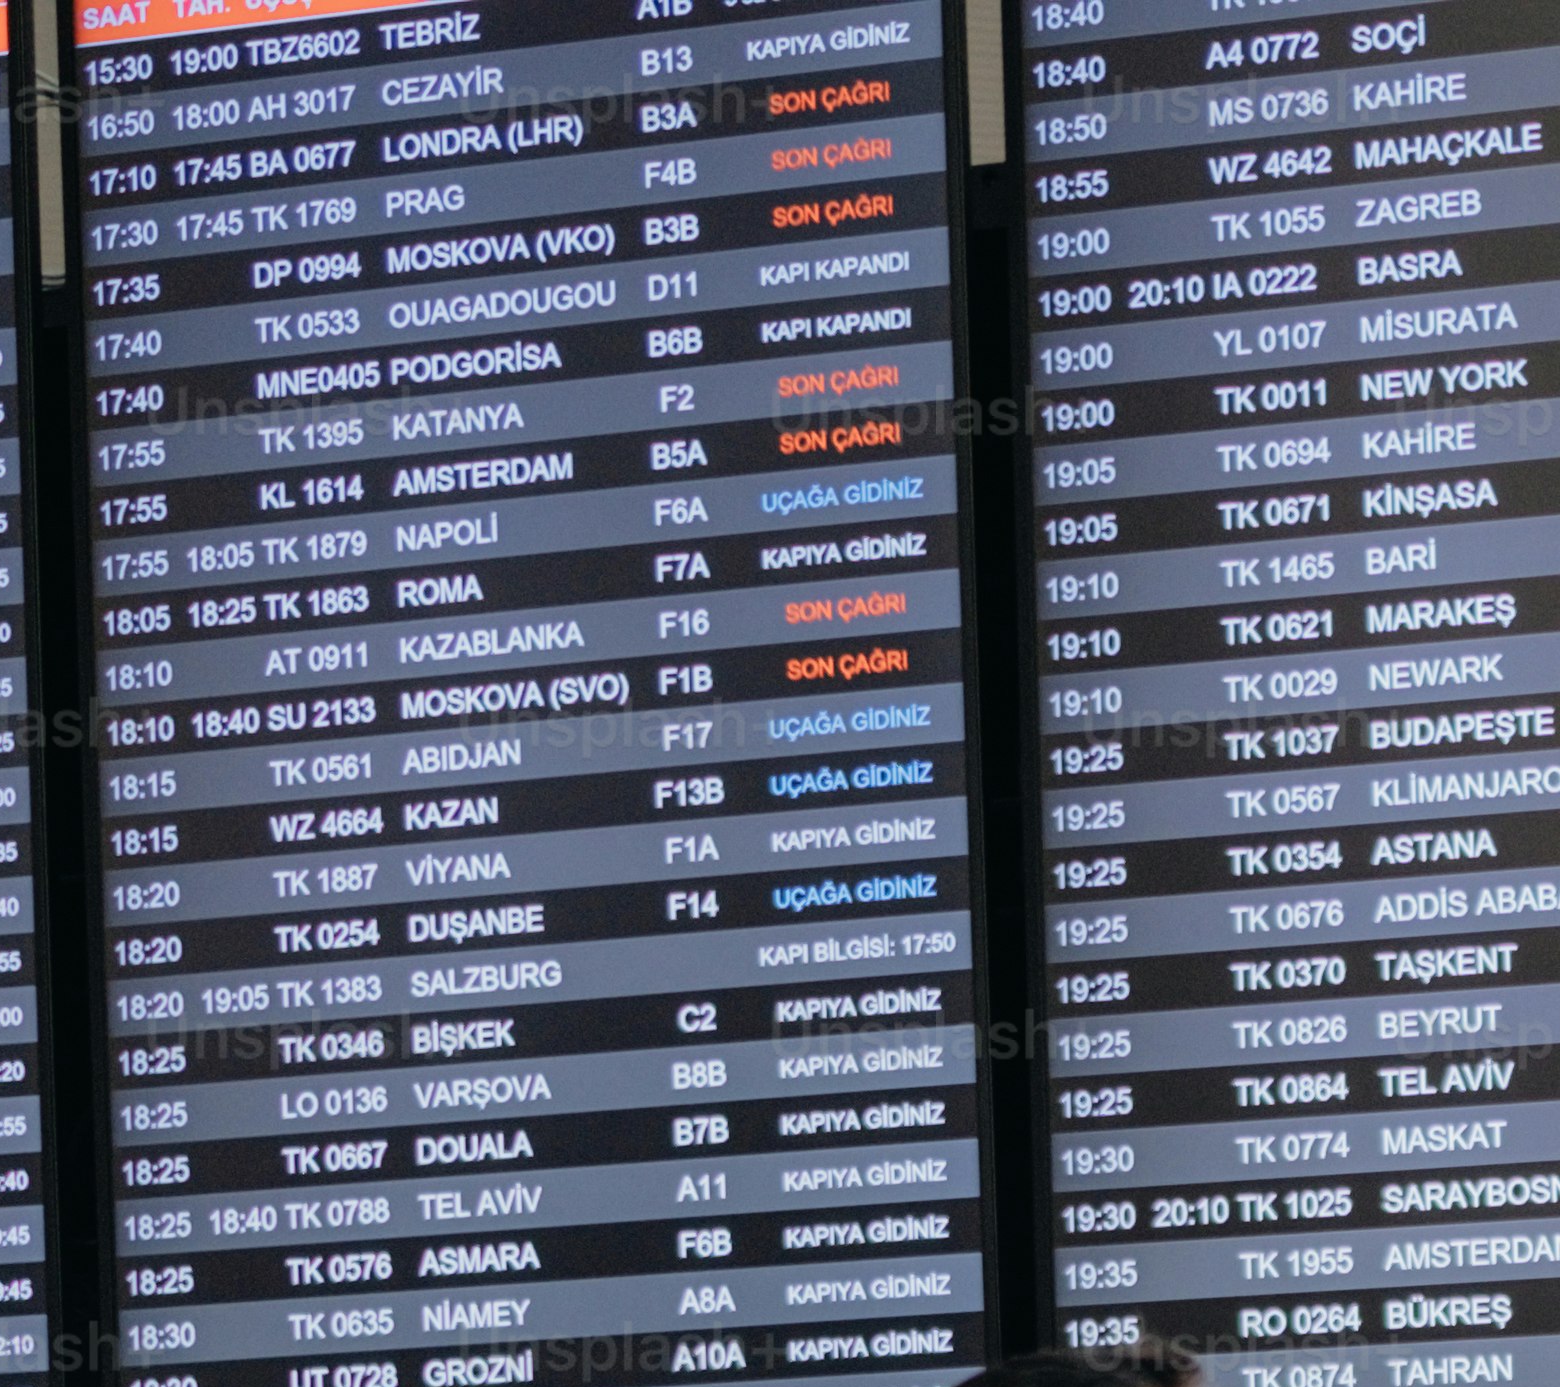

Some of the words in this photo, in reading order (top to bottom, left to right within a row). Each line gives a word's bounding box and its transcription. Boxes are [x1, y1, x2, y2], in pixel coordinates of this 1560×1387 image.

[89, 163, 157, 196] 17:10
[173, 153, 243, 186] 17:45
[249, 149, 289, 178] BA
[292, 139, 357, 173] 0677
[381, 123, 503, 163] LONDRA
[505, 115, 584, 155] (LHR)
[639, 101, 698, 133] B3A
[769, 89, 817, 115] SON
[820, 80, 890, 113] ÇAĞRI
[1035, 169, 1110, 203] 18:55
[1207, 153, 1259, 185] WZ
[1262, 145, 1333, 179] 4642
[1353, 122, 1544, 170] MAHAÇKALE
[96, 384, 165, 417] 17:40
[255, 360, 381, 400] MNE0405
[389, 340, 563, 386] PODGORİSA
[646, 325, 704, 359] B6B
[760, 318, 812, 344] KAPI
[815, 307, 912, 338] KAPANDI
[1041, 398, 1115, 432] 19:00
[1213, 384, 1257, 416] TK
[1260, 378, 1327, 411] 0011
[1359, 367, 1434, 402] NEW
[1438, 358, 1529, 394] YORK
[102, 549, 170, 581] 17:55
[186, 541, 255, 573] 18:05
[260, 536, 300, 565] TK
[306, 529, 368, 561] 1879
[395, 511, 499, 552] NAPOLİ
[653, 495, 709, 527] F6A
[760, 483, 840, 516] UÇAĞA
[842, 475, 924, 505] GİDİNİZ
[121, 1100, 188, 1131] 18:25
[280, 1091, 319, 1120] LO
[324, 1085, 388, 1116] 0136
[412, 1073, 552, 1110] VARŞOVA
[671, 1058, 727, 1090] B8B
[778, 1053, 859, 1079] KAPIYA
[861, 1044, 944, 1073] GİDİNİZ
[1062, 1201, 1137, 1233] 19:30
[1152, 1195, 1230, 1228] 20:10
[1235, 1192, 1279, 1222] TK
[1284, 1186, 1353, 1220] 1025
